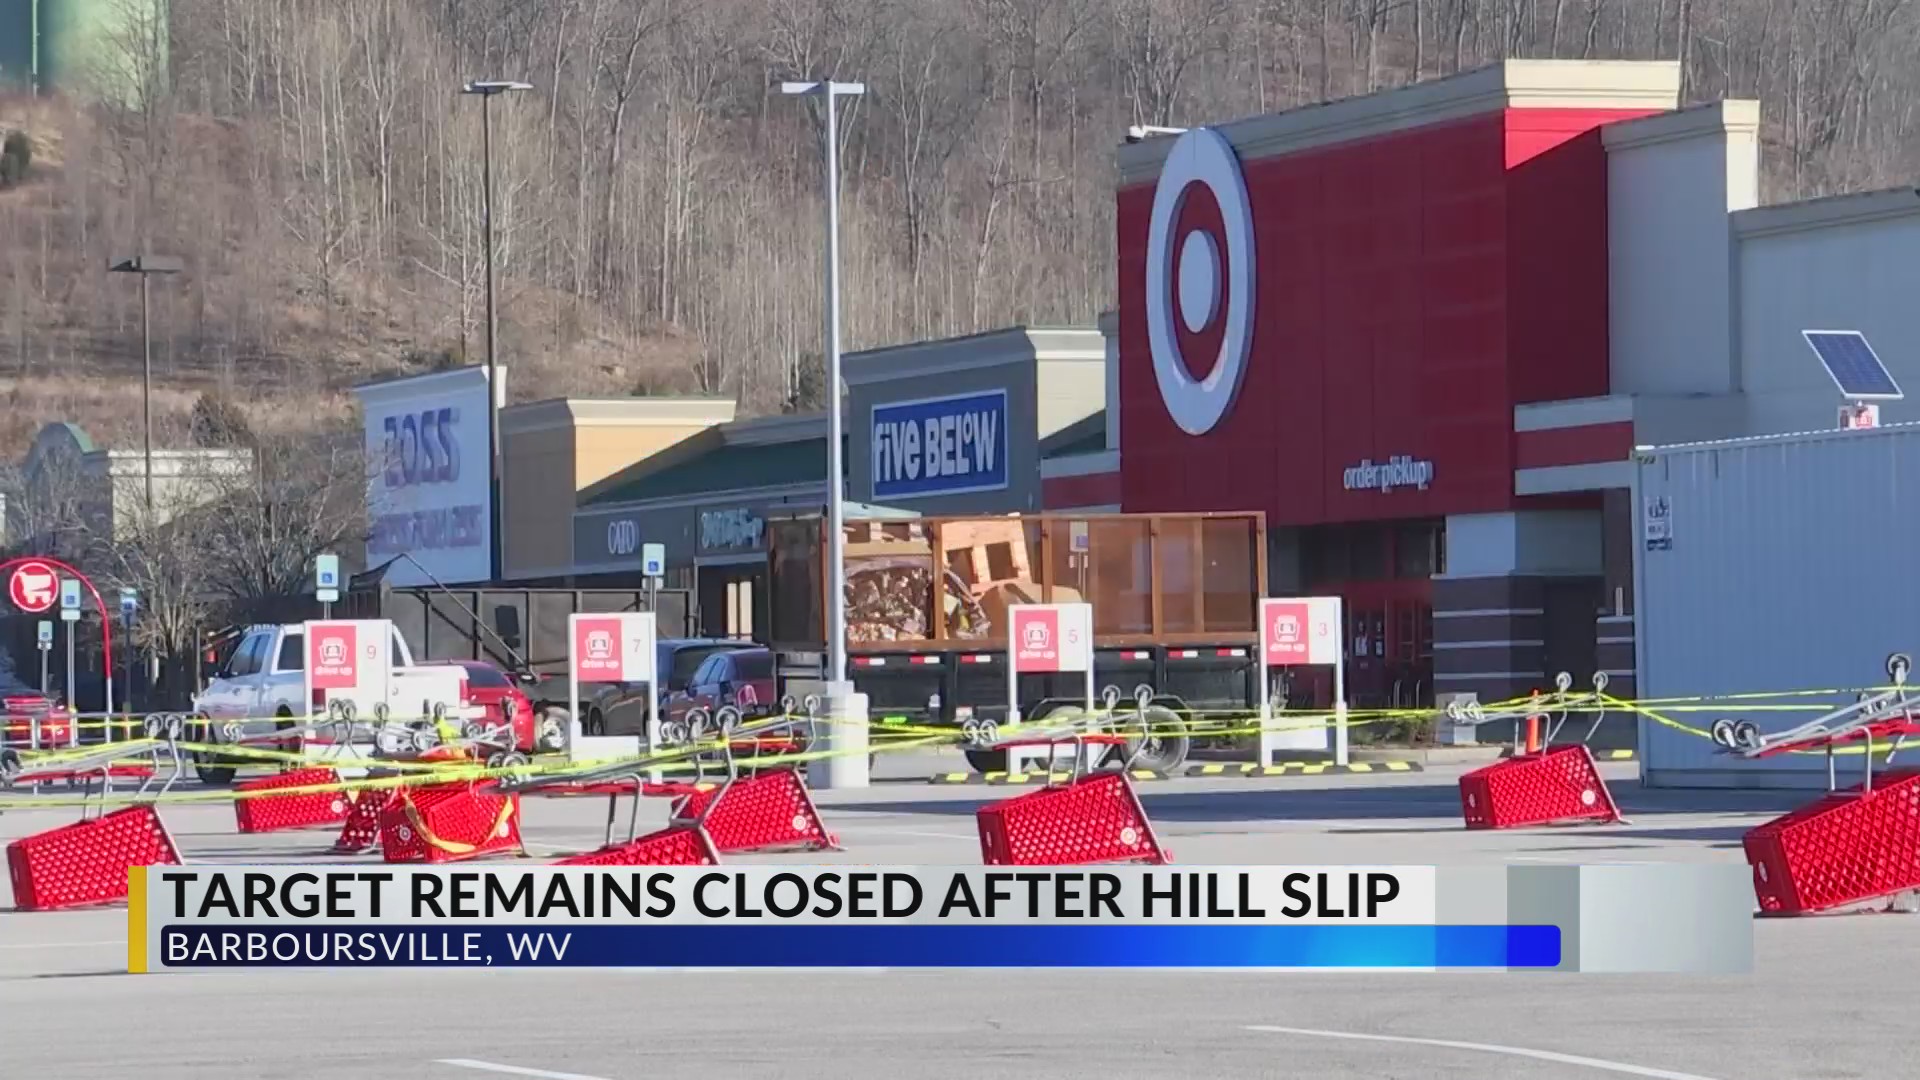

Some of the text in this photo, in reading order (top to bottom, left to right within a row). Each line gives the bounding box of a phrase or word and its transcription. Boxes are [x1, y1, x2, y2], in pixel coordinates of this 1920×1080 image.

[925, 409, 997, 478] BELOW
[1343, 455, 1433, 494] order pickup
[1067, 628, 1078, 644] 5
[1318, 621, 1328, 637] 3
[366, 644, 377, 660] 9
[632, 638, 642, 653] 7
